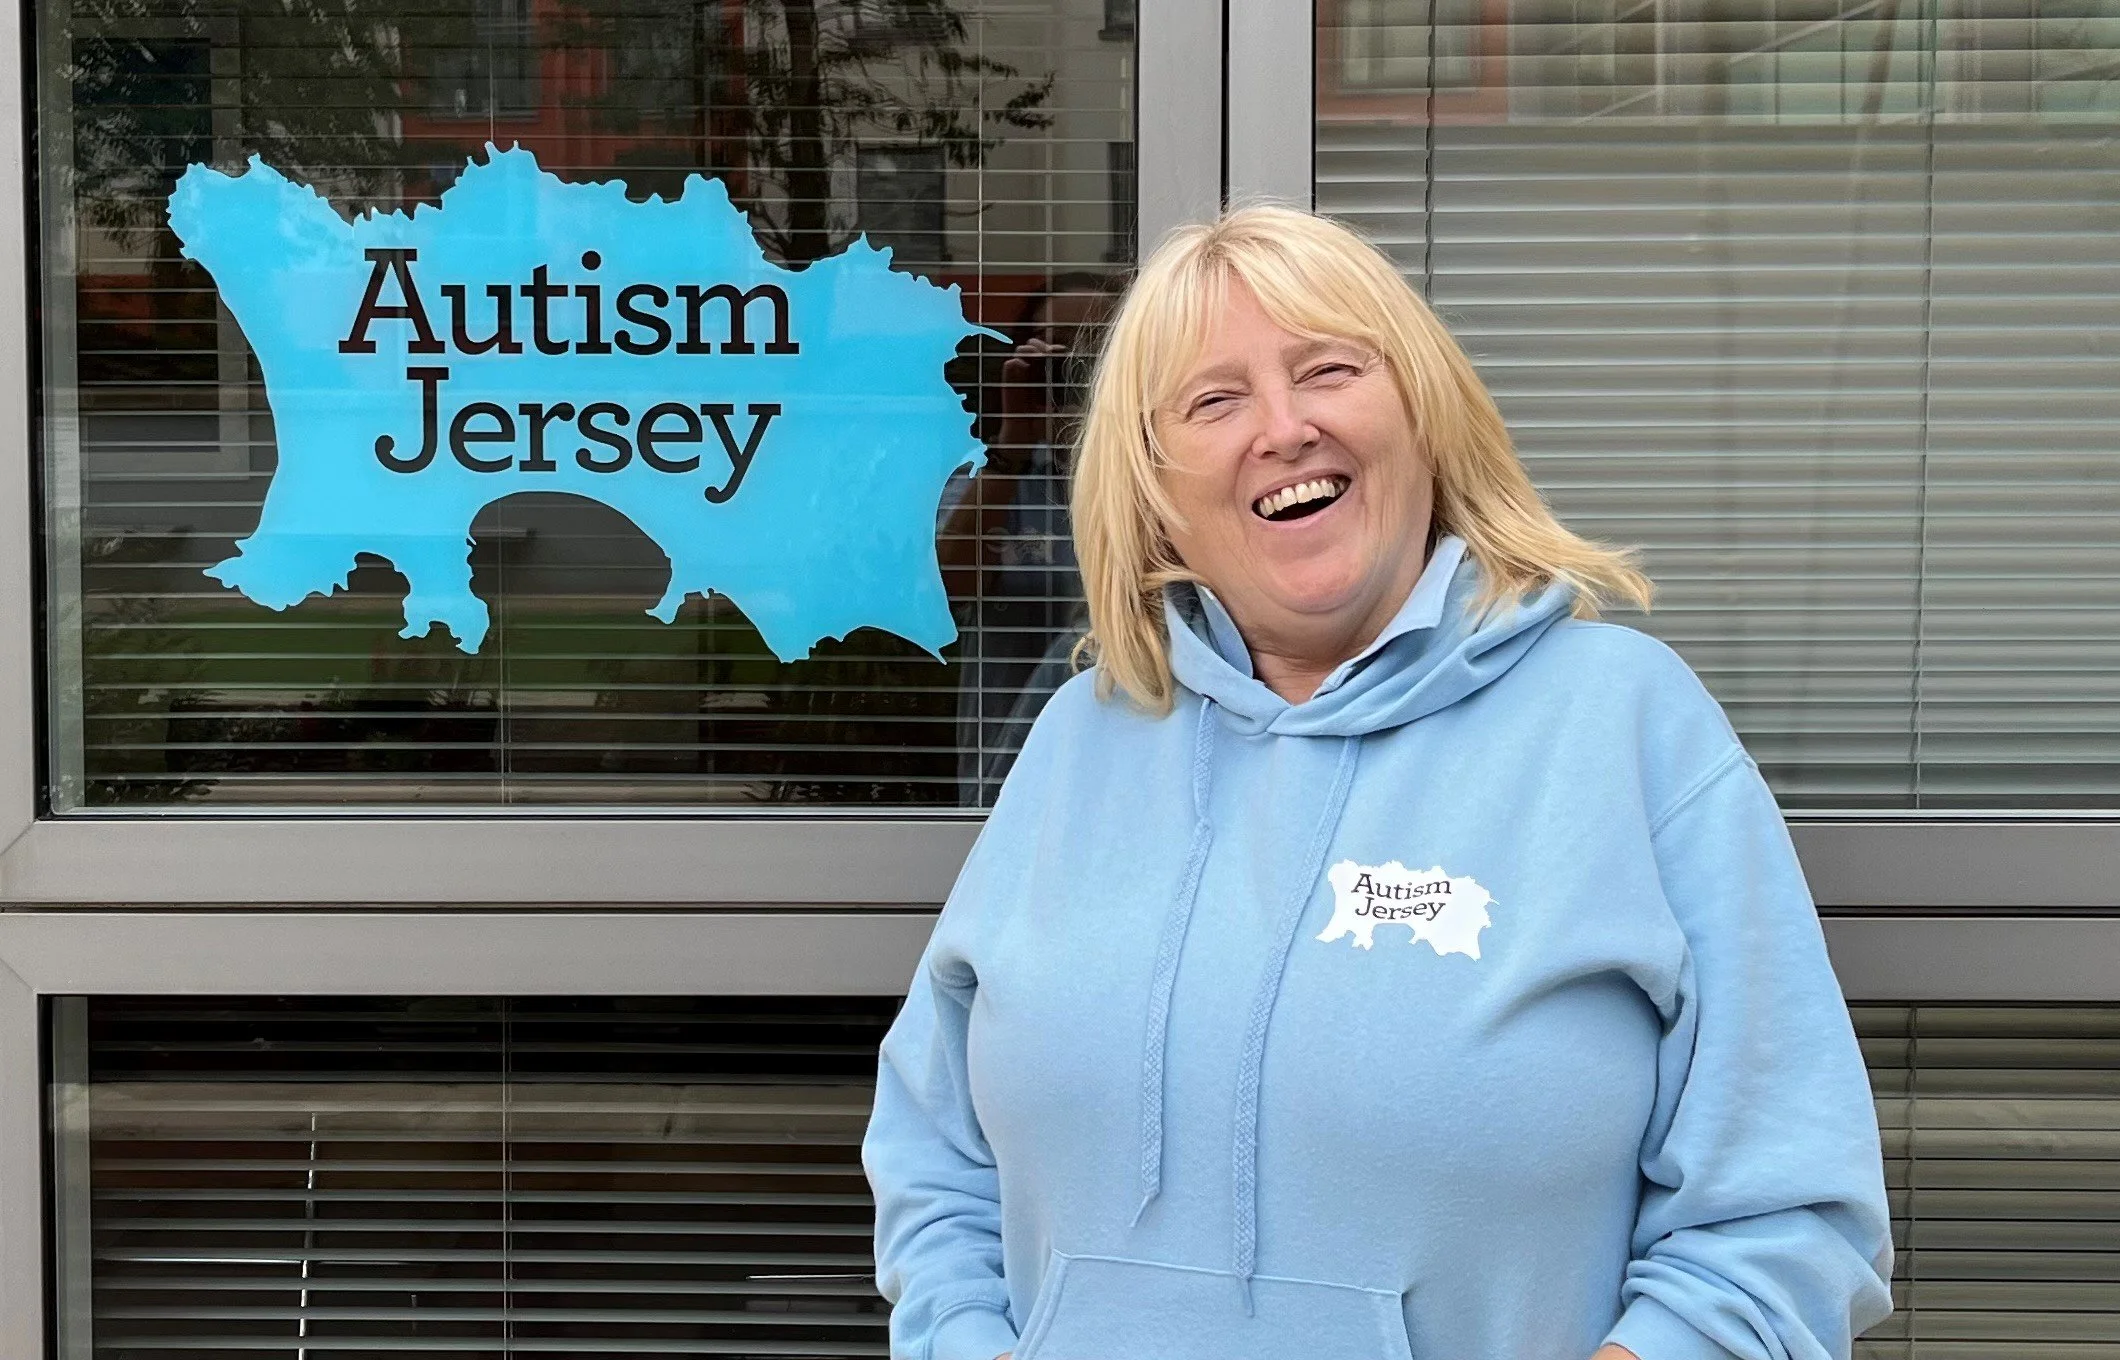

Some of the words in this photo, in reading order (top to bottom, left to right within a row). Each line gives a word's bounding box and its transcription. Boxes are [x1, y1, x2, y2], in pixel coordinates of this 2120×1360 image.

[338, 248, 800, 356] Autism
[374, 366, 783, 504] Jersey
[1351, 872, 1452, 900] Autism
[1354, 896, 1446, 922] Jersey
